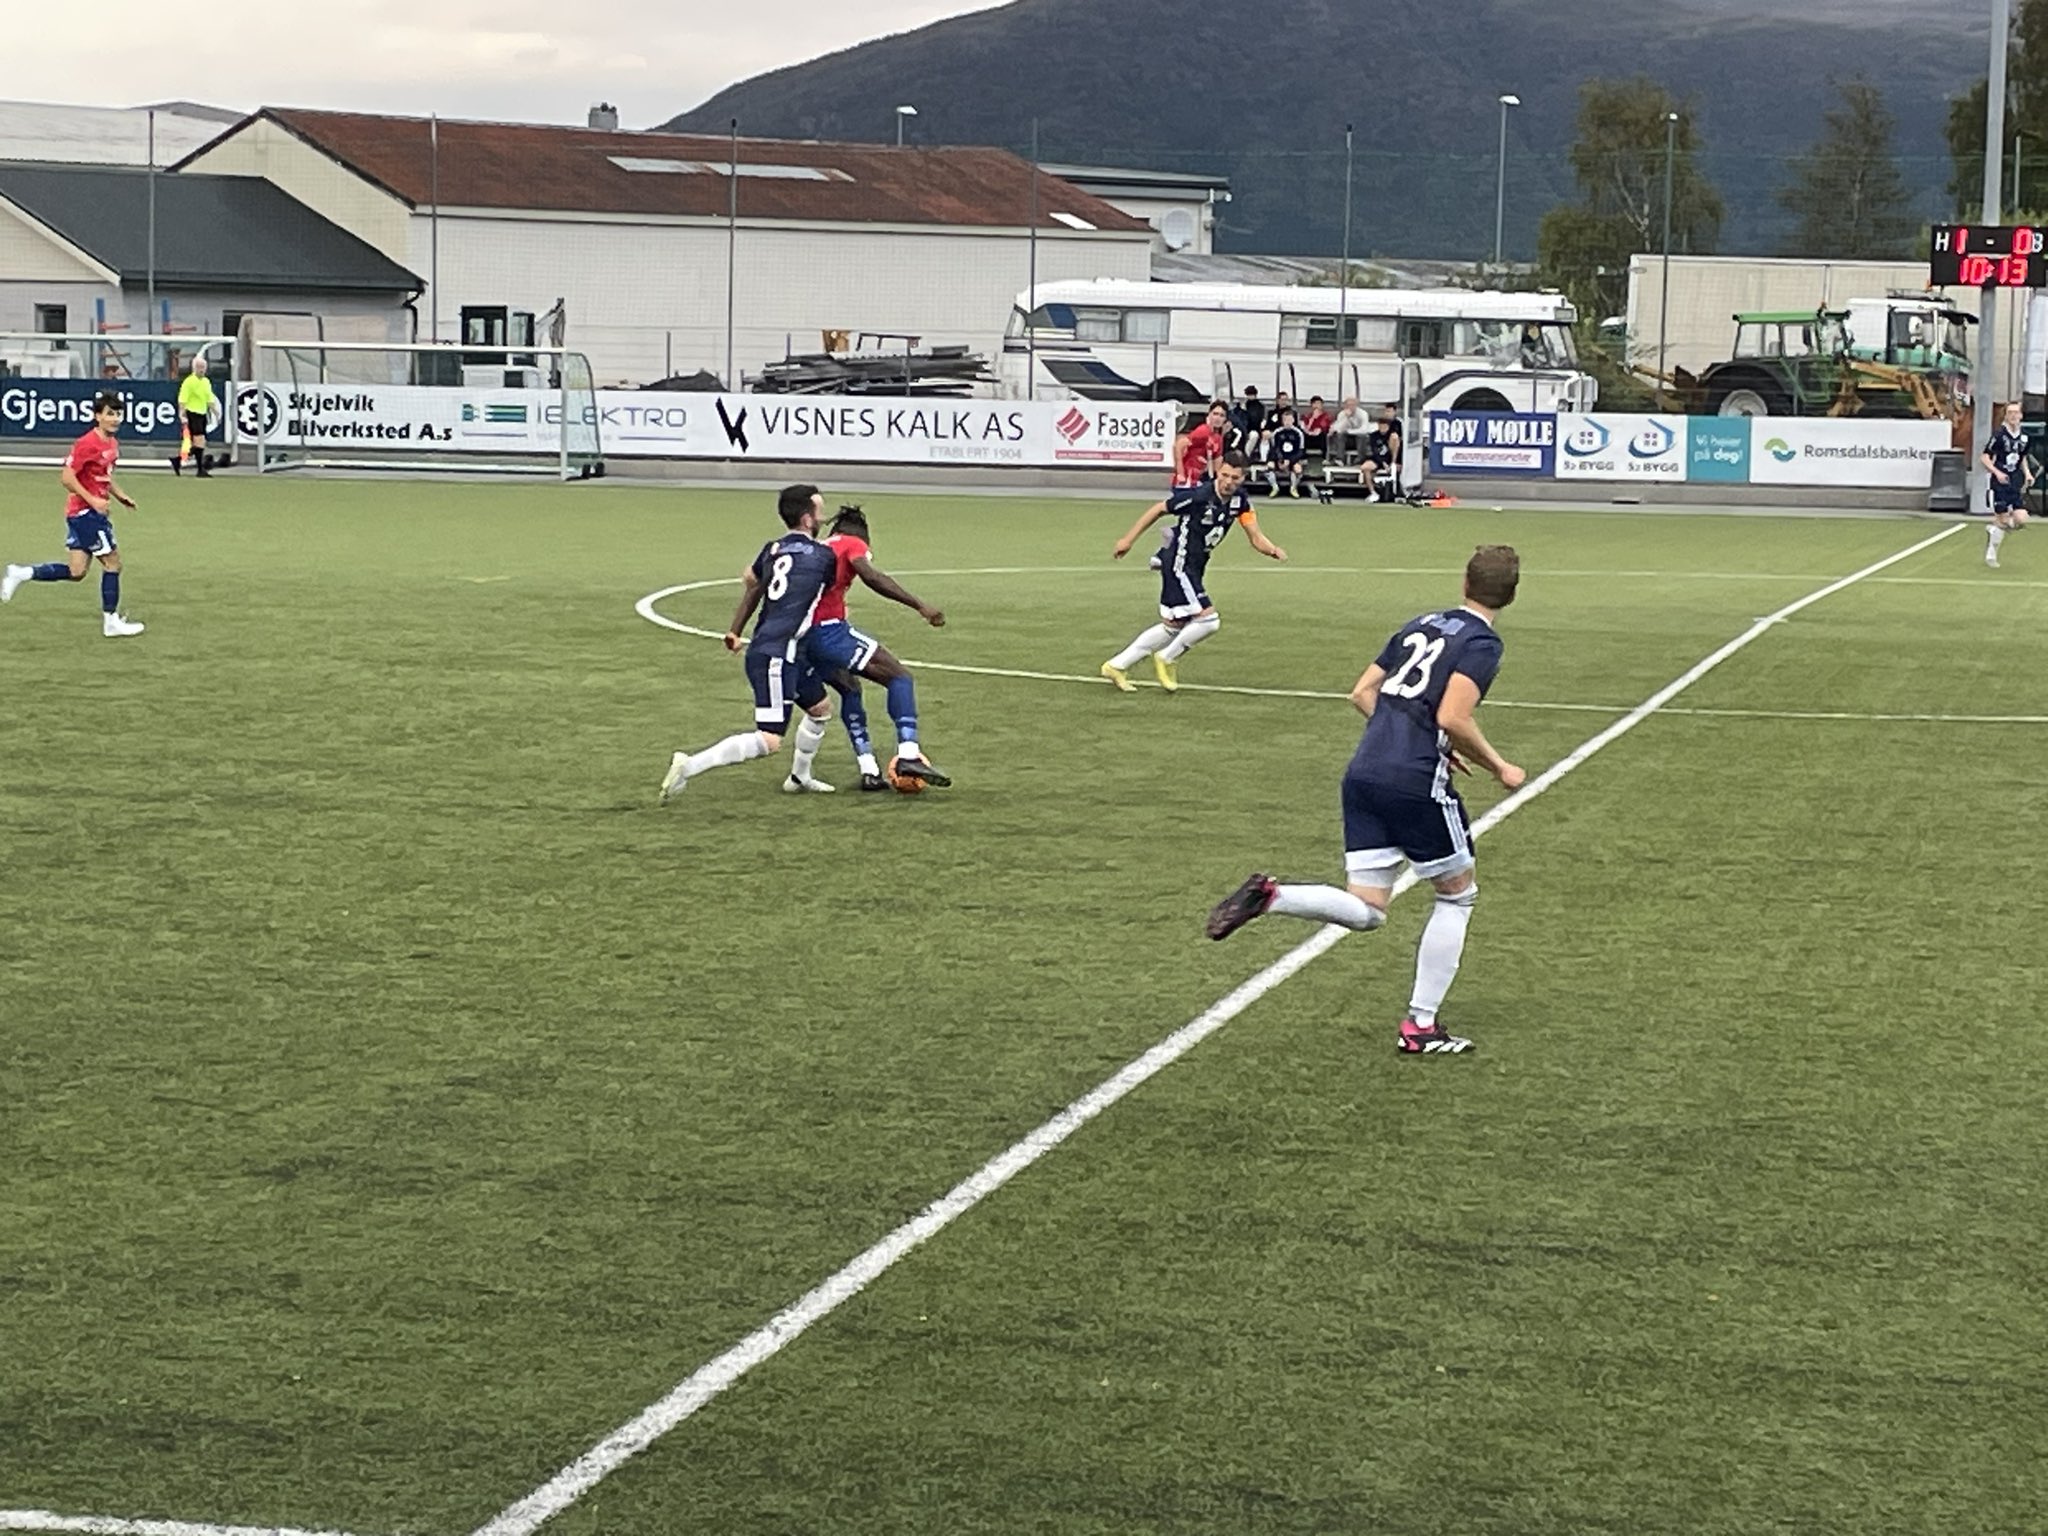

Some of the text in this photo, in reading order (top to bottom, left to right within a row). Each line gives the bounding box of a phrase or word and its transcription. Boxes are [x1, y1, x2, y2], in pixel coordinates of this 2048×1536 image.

[1935, 231, 1950, 252] H
[1955, 228, 1969, 255] 1
[2012, 228, 2032, 255] 0
[2031, 232, 2044, 253] B
[1, 388, 176, 433] Gjensige
[288, 392, 375, 416] Skjelvik
[288, 420, 411, 440] Bilverksted
[760, 405, 1025, 441] VISNES KALK AS
[1098, 411, 1165, 438] Fasade
[1433, 418, 1554, 446] RØV MØLLE
[993, 447, 1023, 460] 1904
[1643, 462, 1680, 473] BYGG
[767, 553, 793, 601] 8
[1380, 632, 1446, 699] 23
